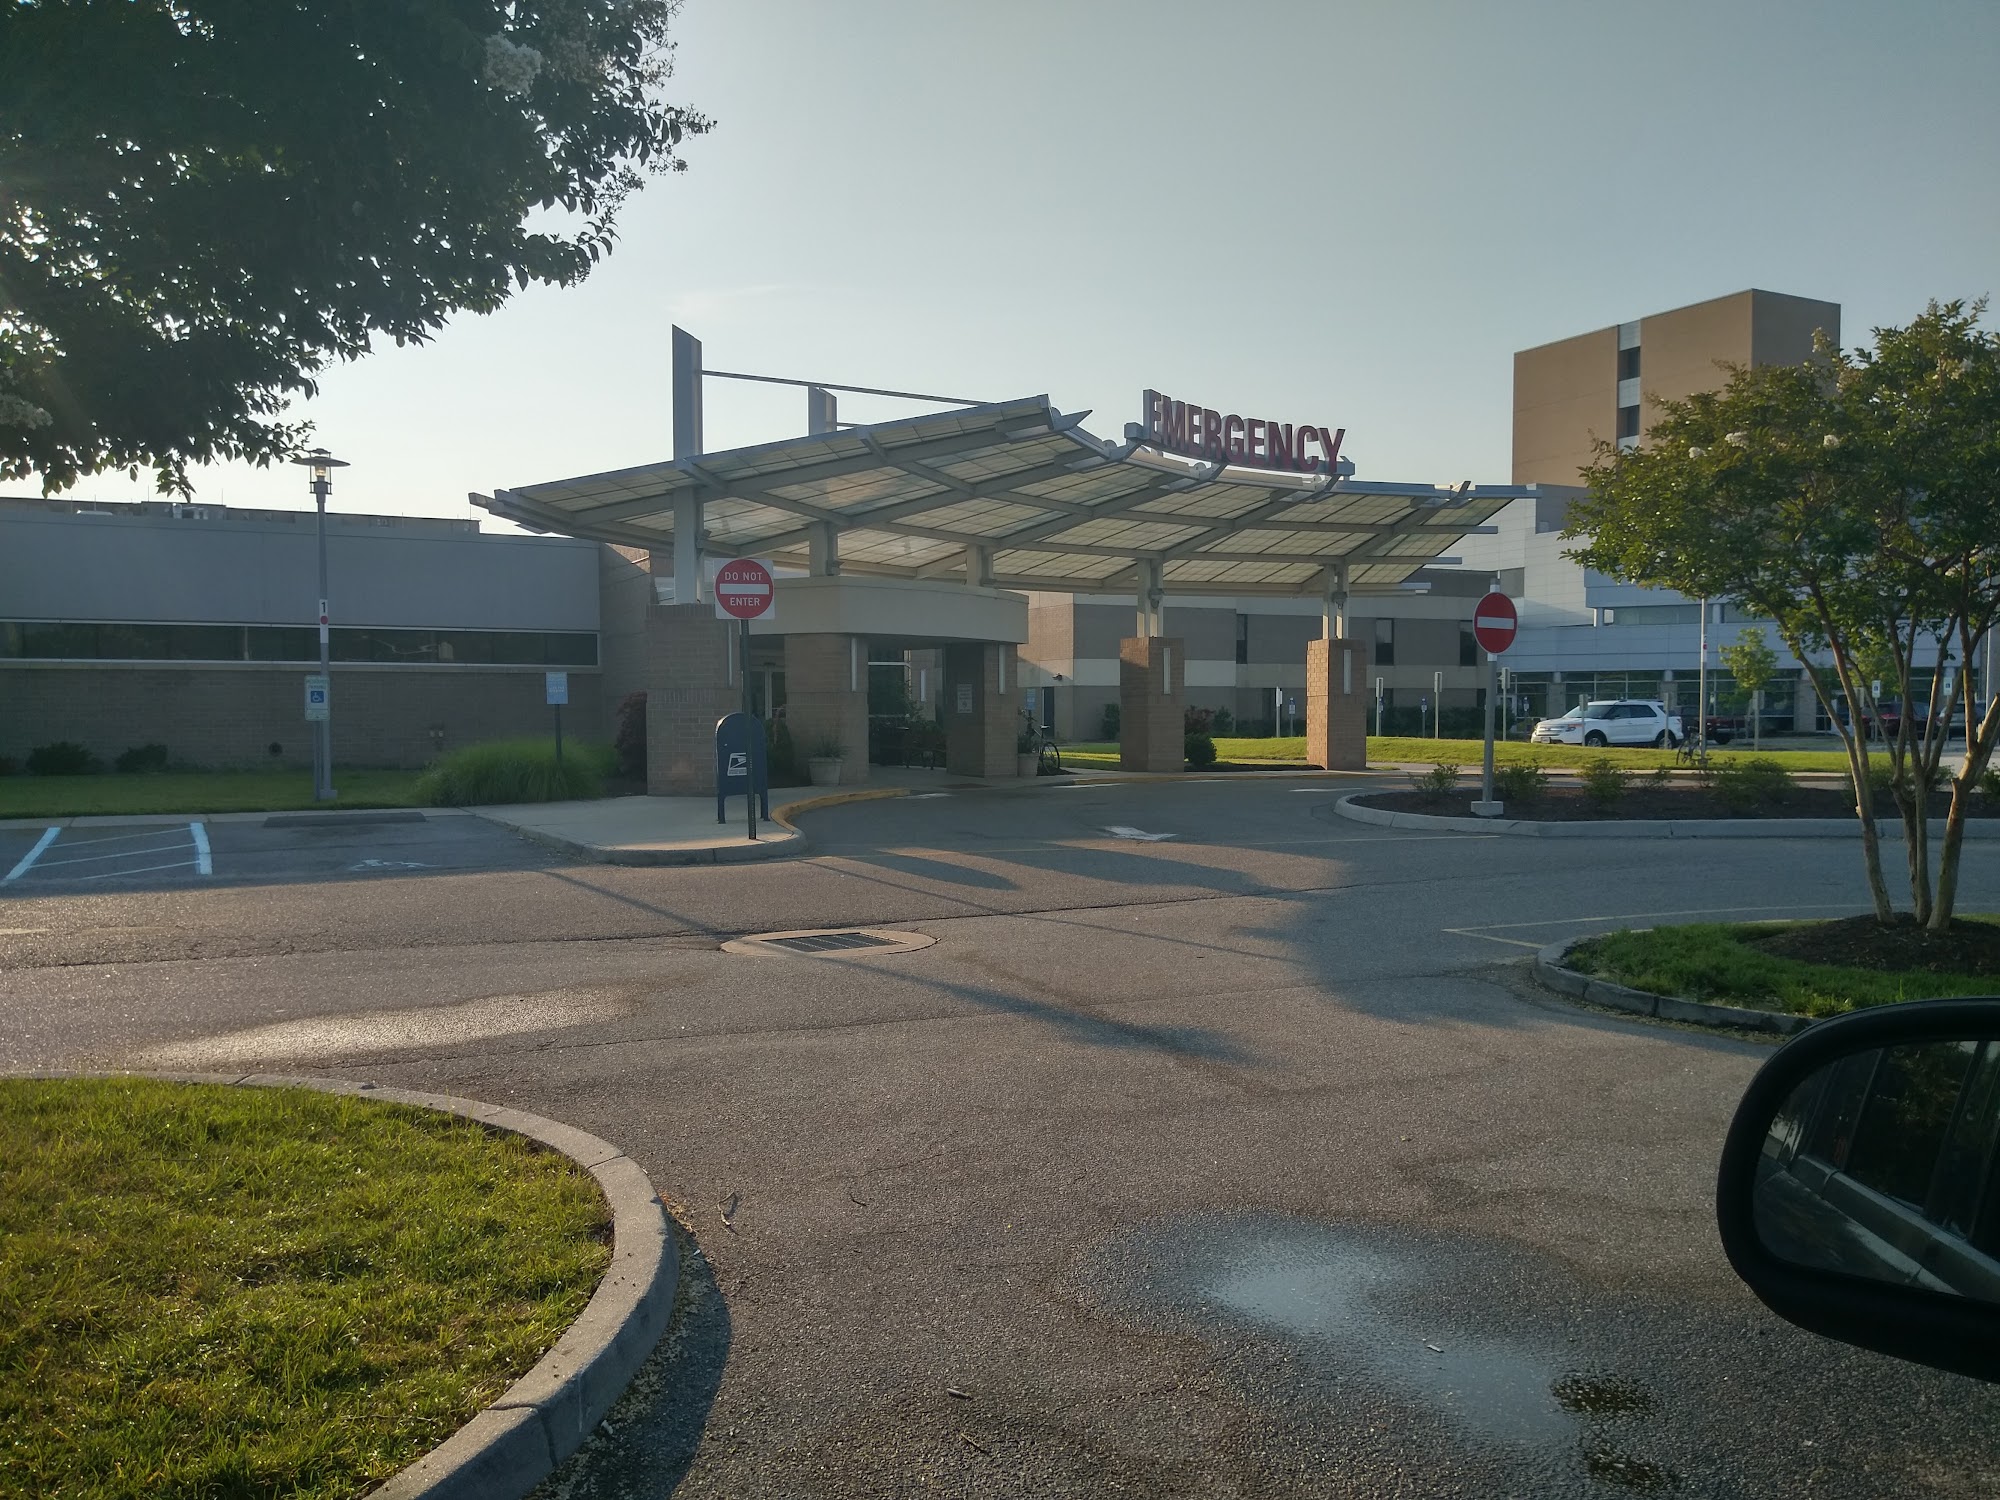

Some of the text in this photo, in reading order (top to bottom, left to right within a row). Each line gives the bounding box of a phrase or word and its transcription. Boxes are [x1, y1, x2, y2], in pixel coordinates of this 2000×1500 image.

[1143, 389, 1346, 474] EMERGENCY
[724, 571, 763, 581] DO NOT
[321, 601, 326, 613] 1
[730, 597, 761, 607] ENTER
